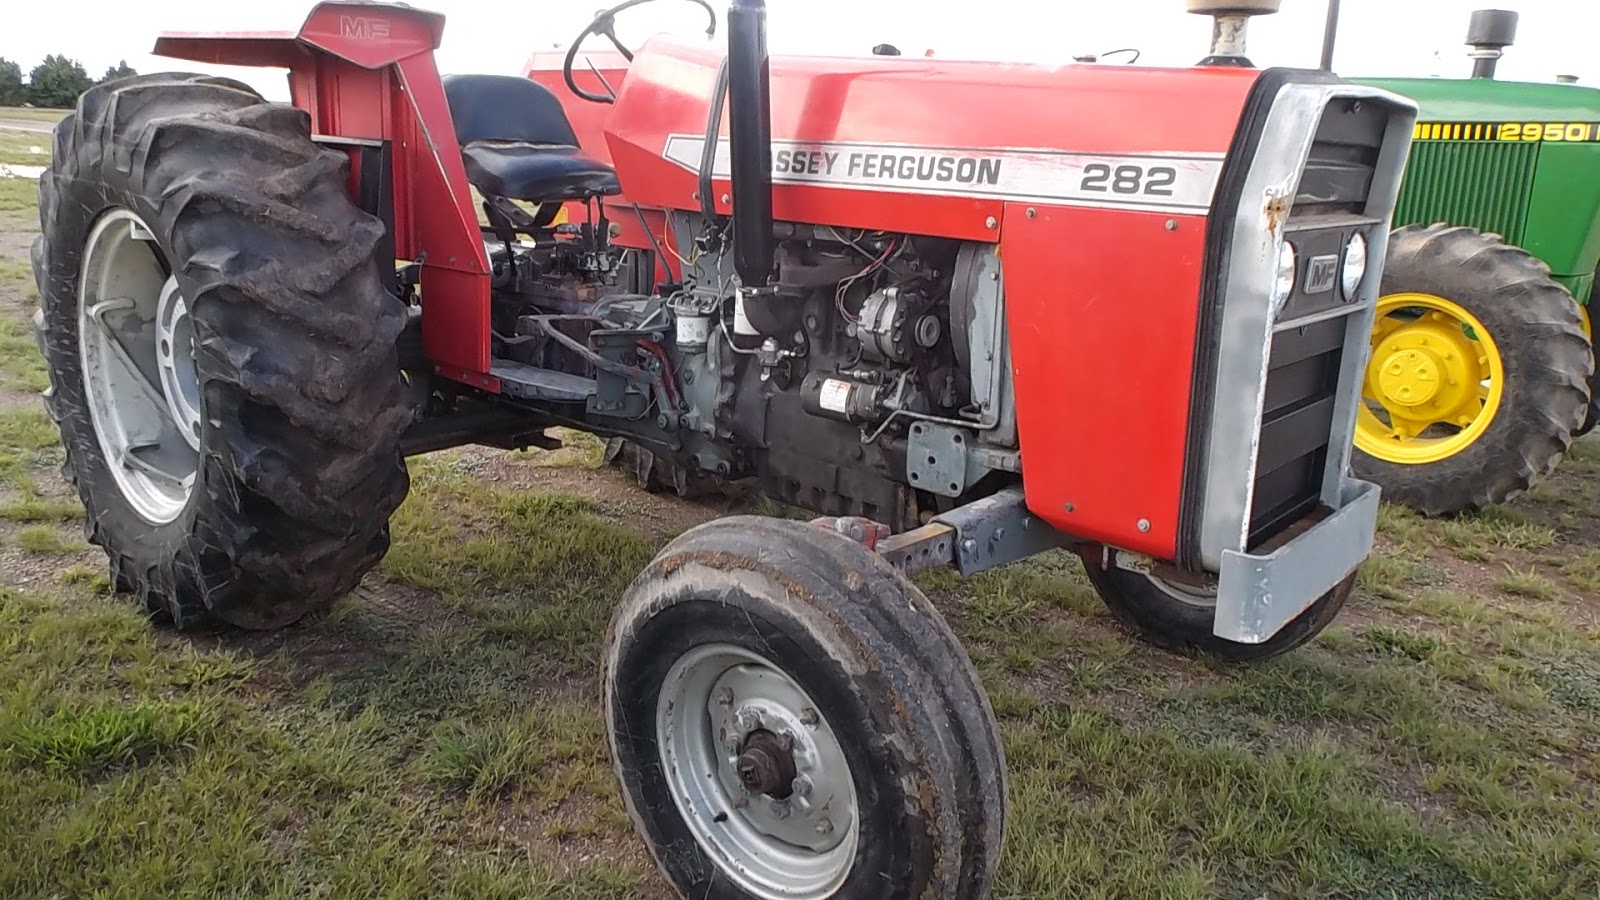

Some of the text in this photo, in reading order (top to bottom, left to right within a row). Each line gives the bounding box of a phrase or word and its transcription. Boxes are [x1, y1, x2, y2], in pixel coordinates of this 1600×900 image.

[340, 15, 391, 39] MF
[1501, 123, 1586, 141] 2950
[772, 149, 1177, 196] SSEY FERGUSON 282
[1311, 262, 1336, 288] MF
